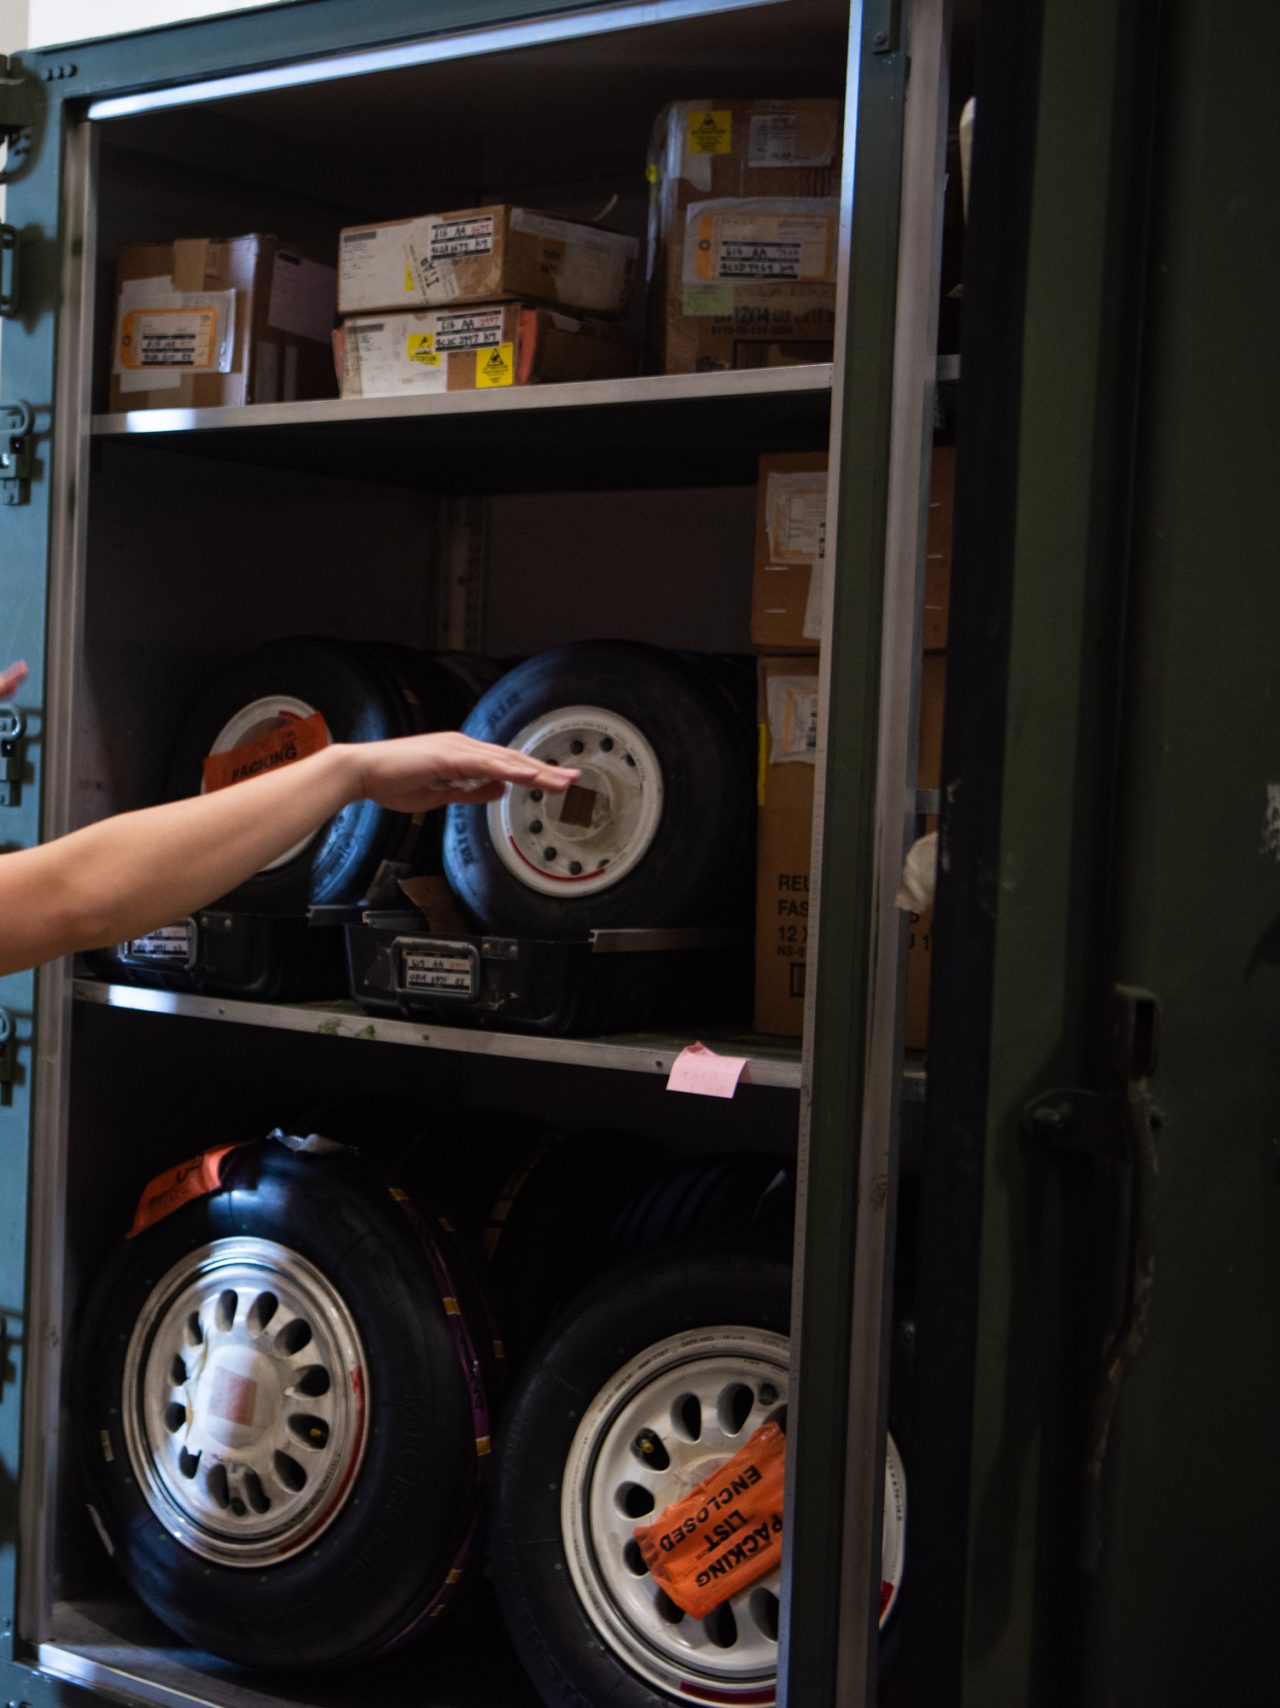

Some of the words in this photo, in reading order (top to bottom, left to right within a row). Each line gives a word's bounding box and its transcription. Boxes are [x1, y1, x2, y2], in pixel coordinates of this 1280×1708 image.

[231, 746, 298, 782] PACKING
[658, 1463, 763, 1553] ENCLOSED
[703, 1508, 750, 1553] LIST
[695, 1513, 783, 1588] PACKING
